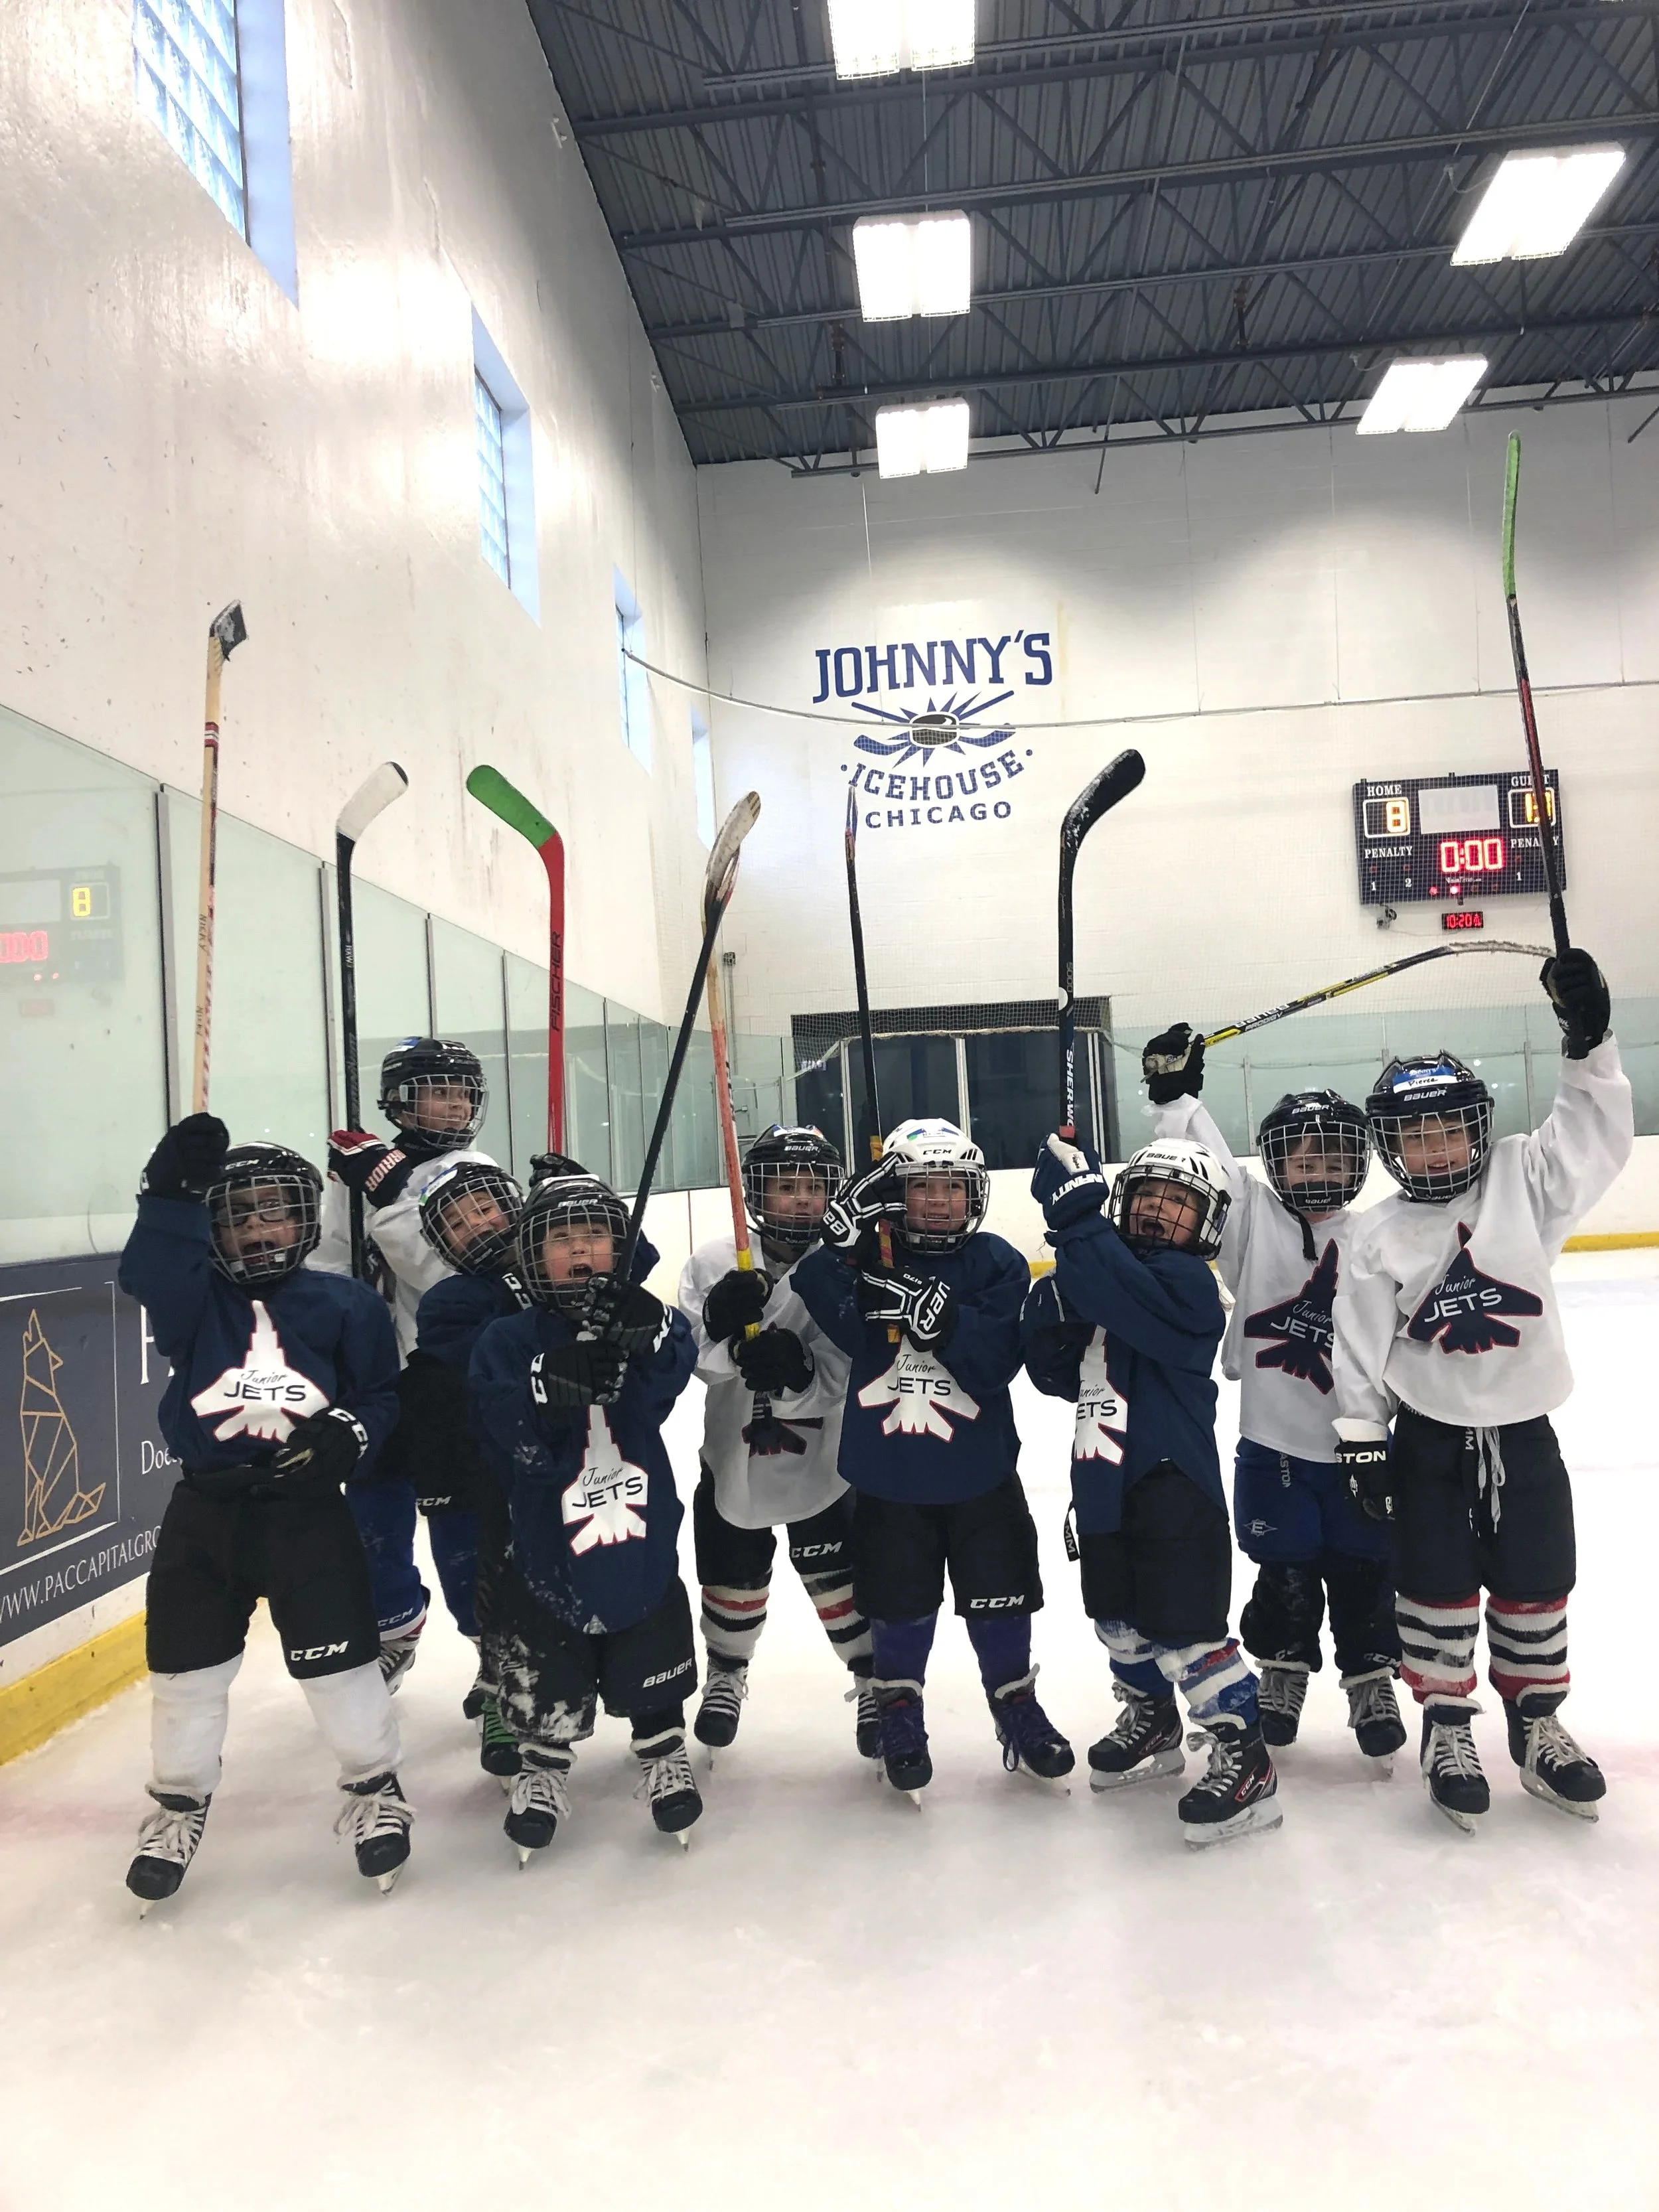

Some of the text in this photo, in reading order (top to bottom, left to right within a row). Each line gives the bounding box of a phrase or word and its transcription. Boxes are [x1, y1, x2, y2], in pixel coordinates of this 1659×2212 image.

[813, 629, 1052, 703] JOHNNY'S
[849, 749, 1025, 801] ICEHOUSE
[1367, 784, 1402, 796] HOME
[865, 801, 1012, 829] CHICAGO
[1386, 800, 1408, 833] 8
[1364, 846, 1413, 859] PENALTY
[1511, 836, 1559, 849] PENAY
[1441, 838, 1503, 873] 0:00
[1405, 878, 1412, 888] 2
[551, 931, 561, 1031] FISCHER
[1404, 1088, 1447, 1102] BAUER
[1292, 1104, 1329, 1114] BAUER
[225, 1159, 259, 1170] CCM
[1435, 1274, 1476, 1295] Junior
[1293, 1300, 1333, 1324] Junior
[1424, 1288, 1502, 1323] JETS
[896, 1353, 937, 1374] Junior
[241, 1369, 287, 1383] Junior
[887, 1377, 951, 1396] JETS
[224, 1382, 305, 1402] JETS
[1077, 1399, 1118, 1420] ETS
[583, 1467, 624, 1486] Junior
[572, 1476, 643, 1508] JETS
[791, 1541, 843, 1558] CCM
[970, 1594, 1025, 1609] CCM
[378, 1607, 413, 1627] CCM
[290, 1640, 349, 1662] CCM
[643, 1658, 693, 1689] BAUER
[1241, 1773, 1255, 1797] CCM
